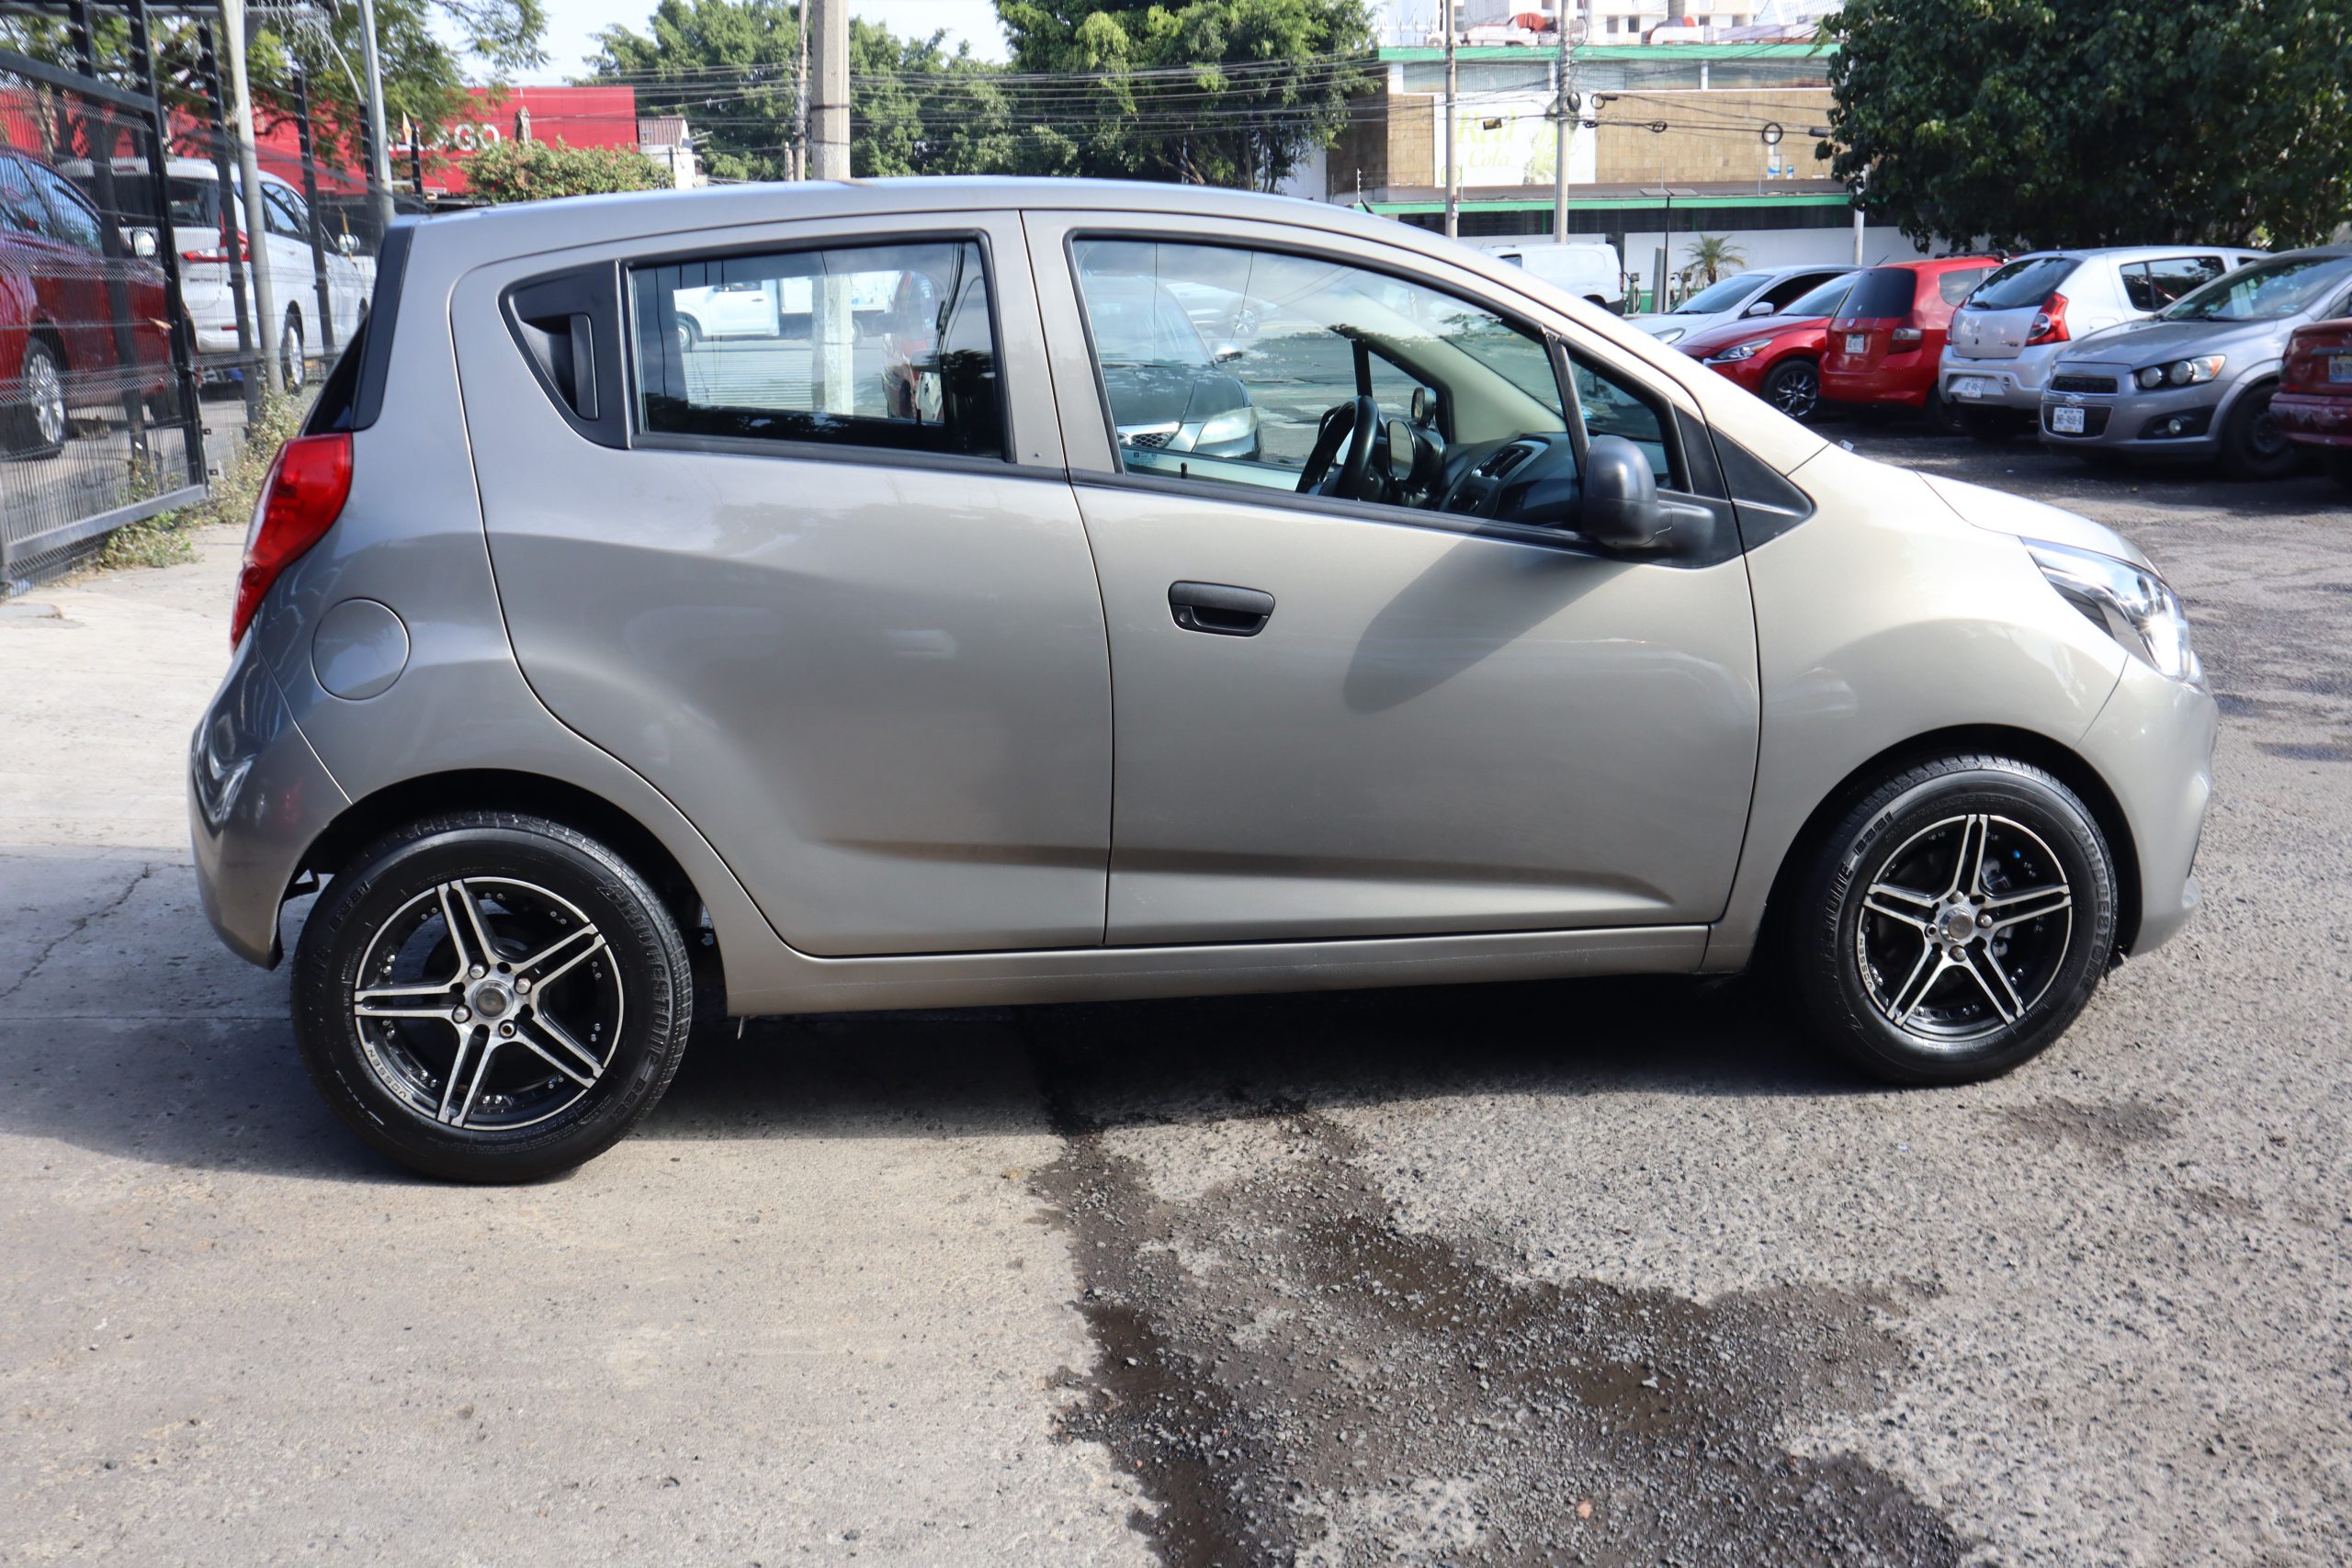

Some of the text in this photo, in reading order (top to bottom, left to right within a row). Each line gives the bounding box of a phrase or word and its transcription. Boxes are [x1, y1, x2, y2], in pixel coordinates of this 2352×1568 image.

[1859, 938, 1872, 988] VOSSEN
[2071, 829, 2110, 992] BRIDGESTONE
[596, 878, 670, 1067] BRIDGESTONE
[368, 1049, 407, 1099] VOSSEN
